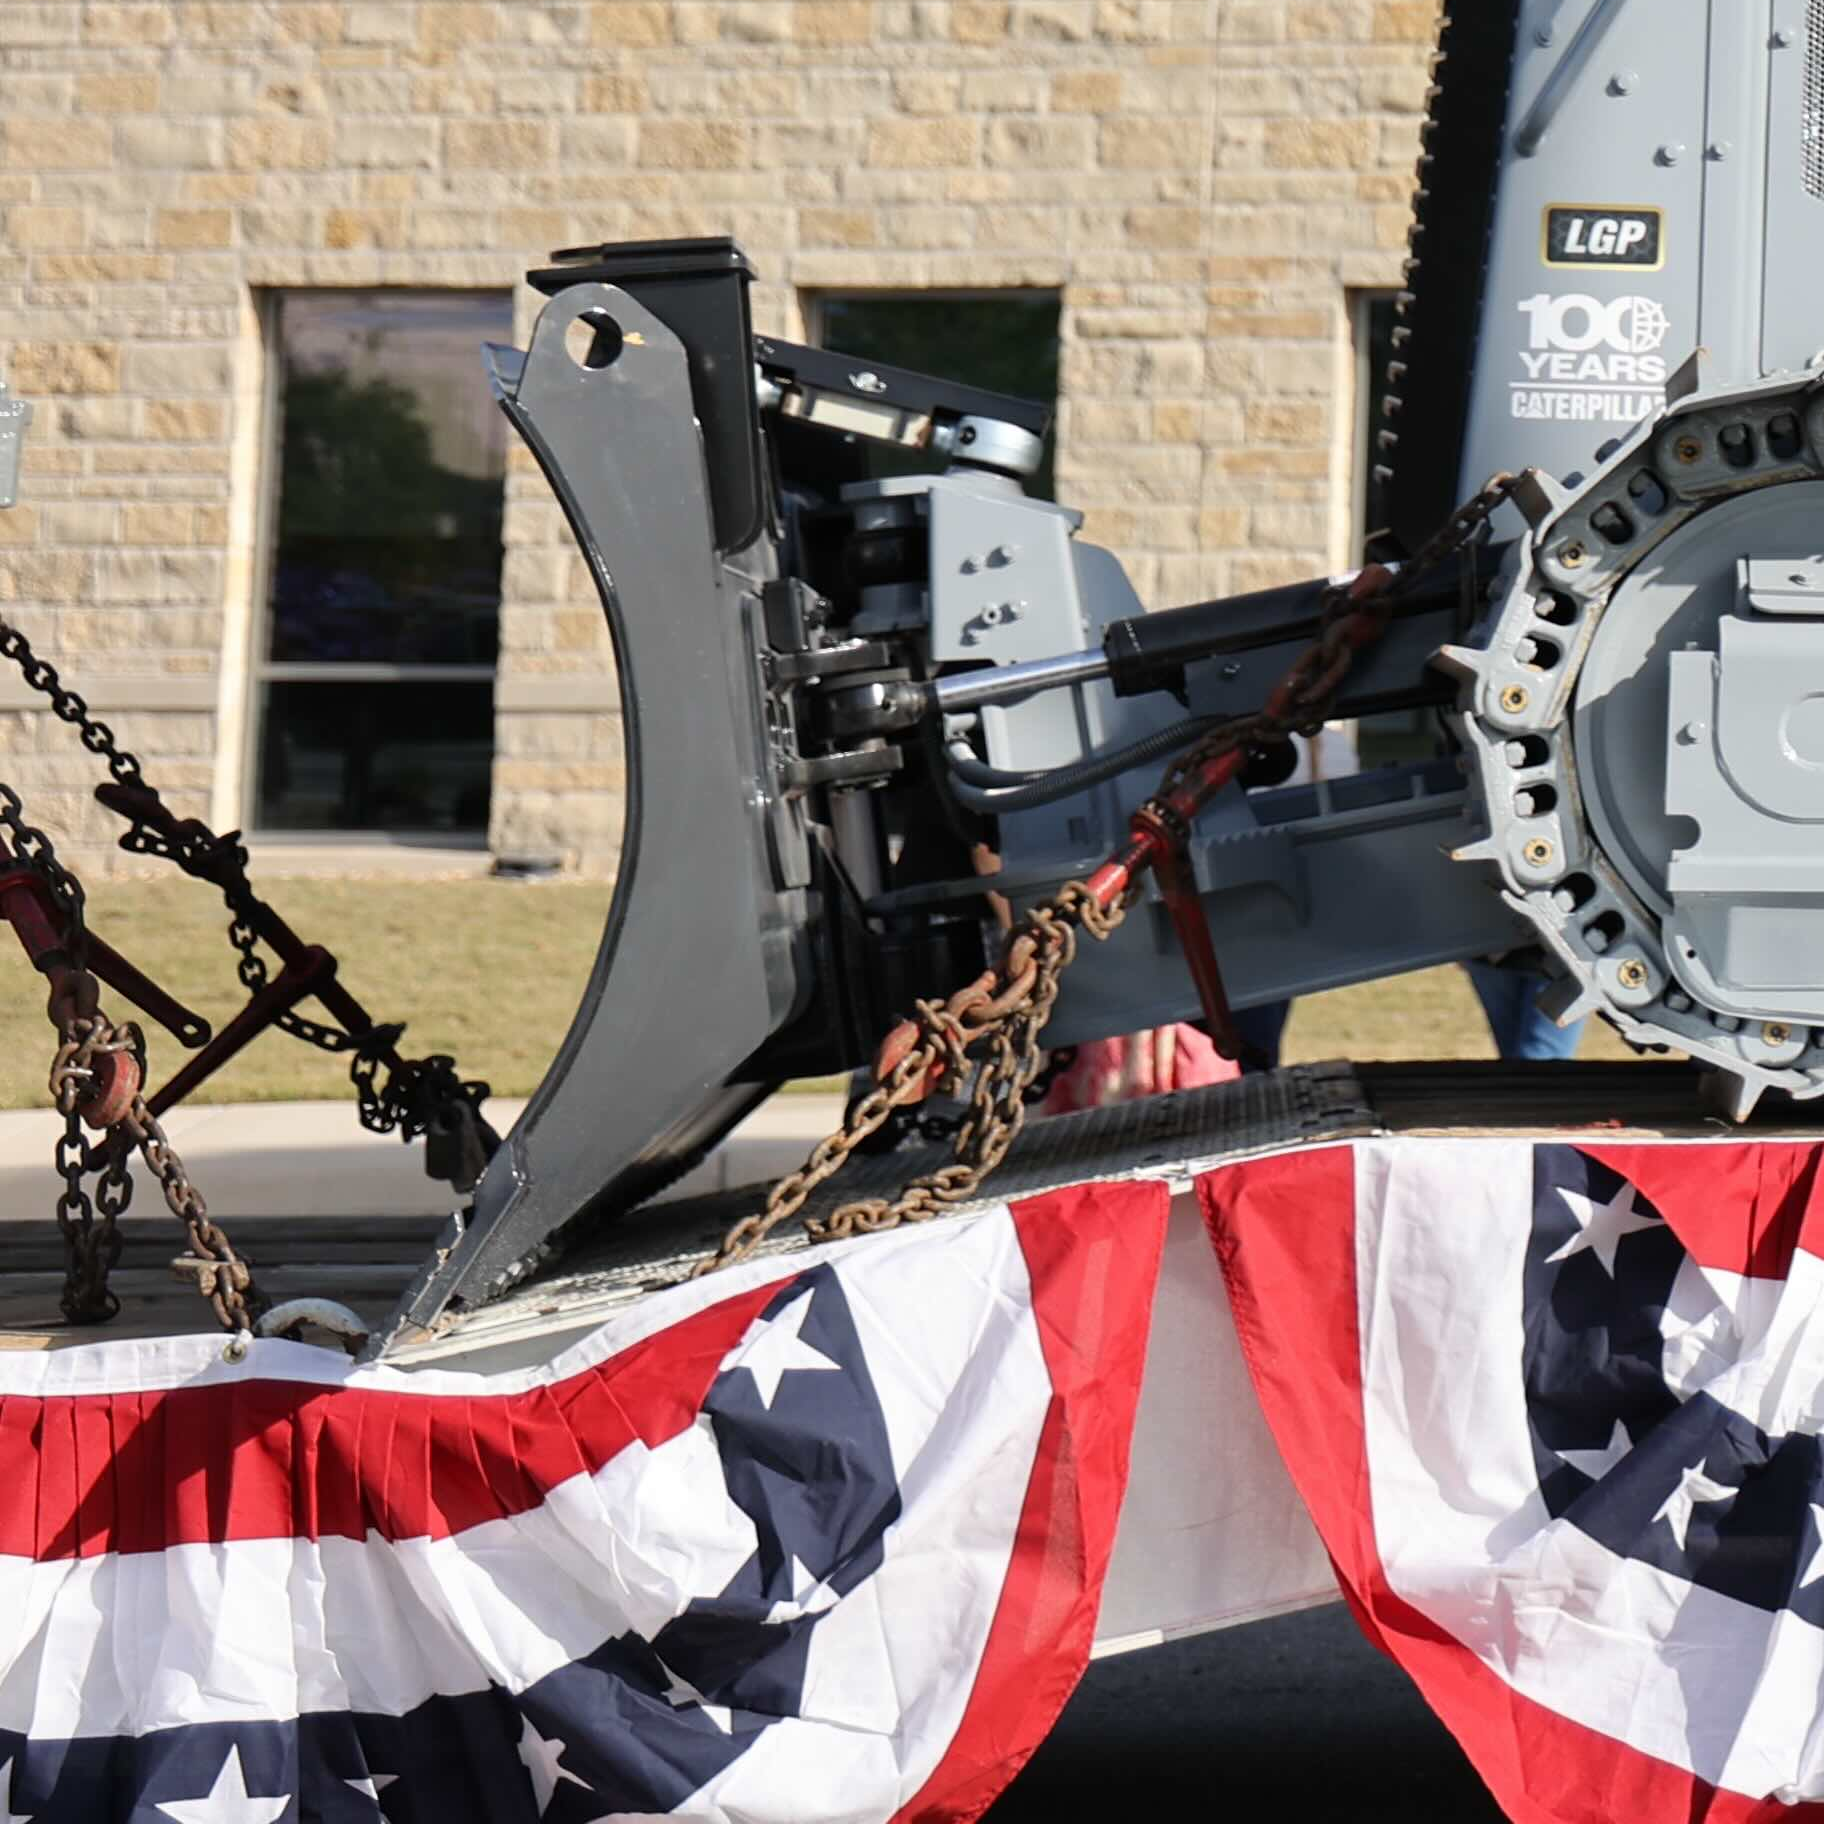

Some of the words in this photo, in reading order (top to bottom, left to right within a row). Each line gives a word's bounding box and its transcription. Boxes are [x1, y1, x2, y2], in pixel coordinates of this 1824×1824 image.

[1563, 218, 1648, 256] LGP
[1517, 293, 1670, 353] 100
[1518, 352, 1666, 382] YEARS
